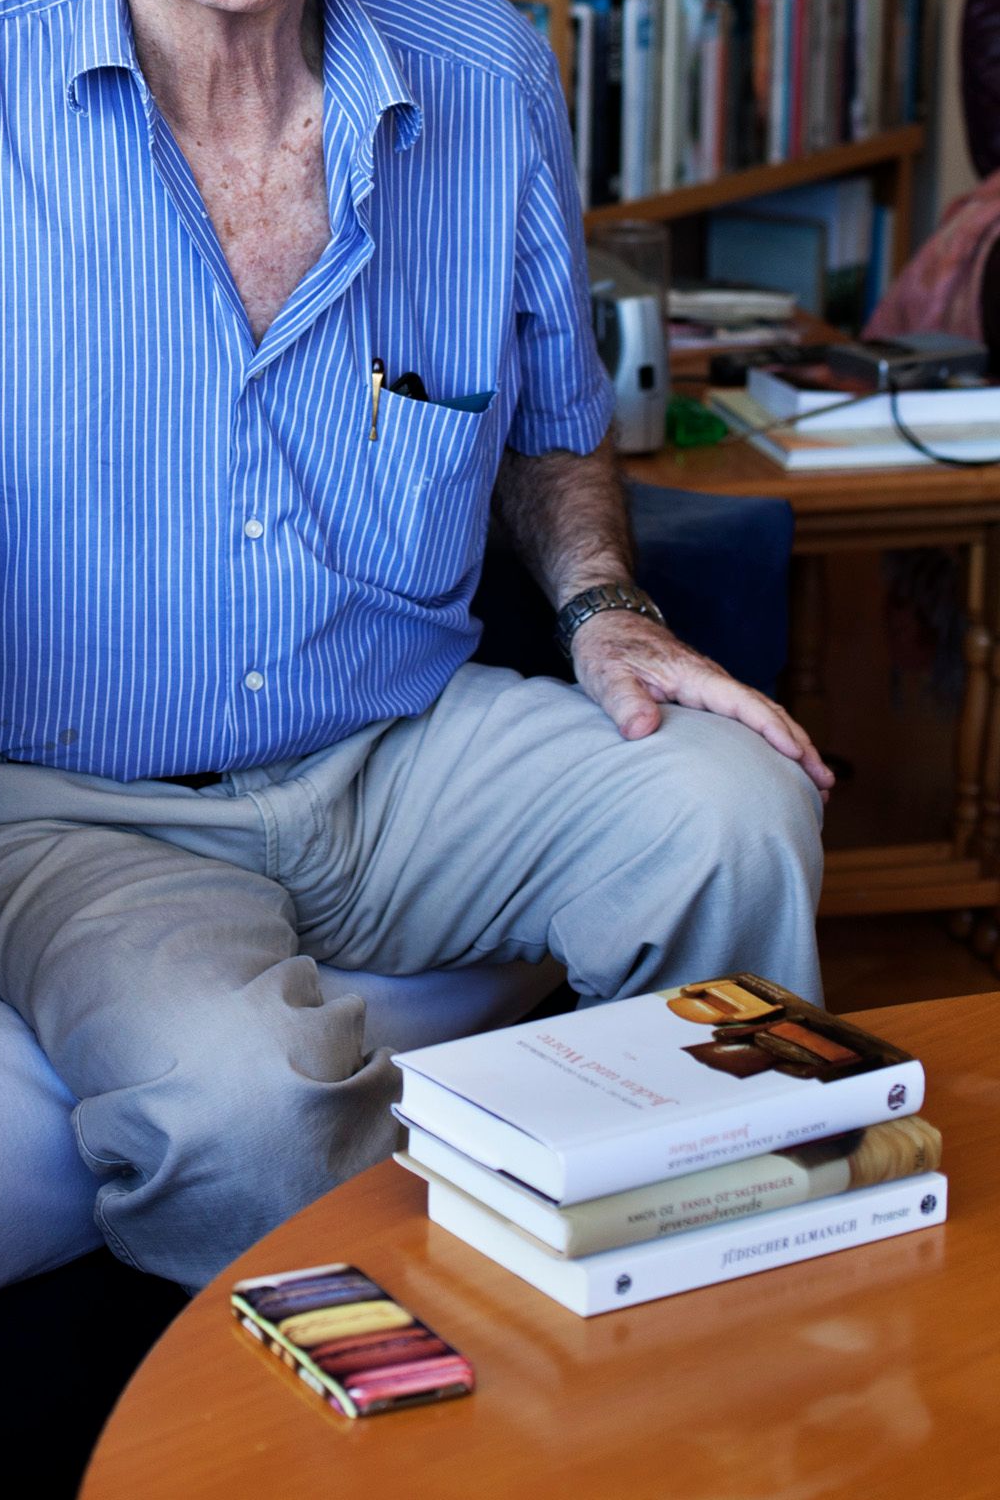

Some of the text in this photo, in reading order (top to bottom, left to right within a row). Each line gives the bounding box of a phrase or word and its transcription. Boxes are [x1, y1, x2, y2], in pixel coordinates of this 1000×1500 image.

[578, 1061, 620, 1081] und
[627, 1208, 657, 1224] AMOS
[659, 1204, 675, 1216] OZ
[680, 1198, 712, 1212] FANIA
[721, 1237, 790, 1269] JÜDISCHER
[793, 1219, 858, 1246] ALMANACH
